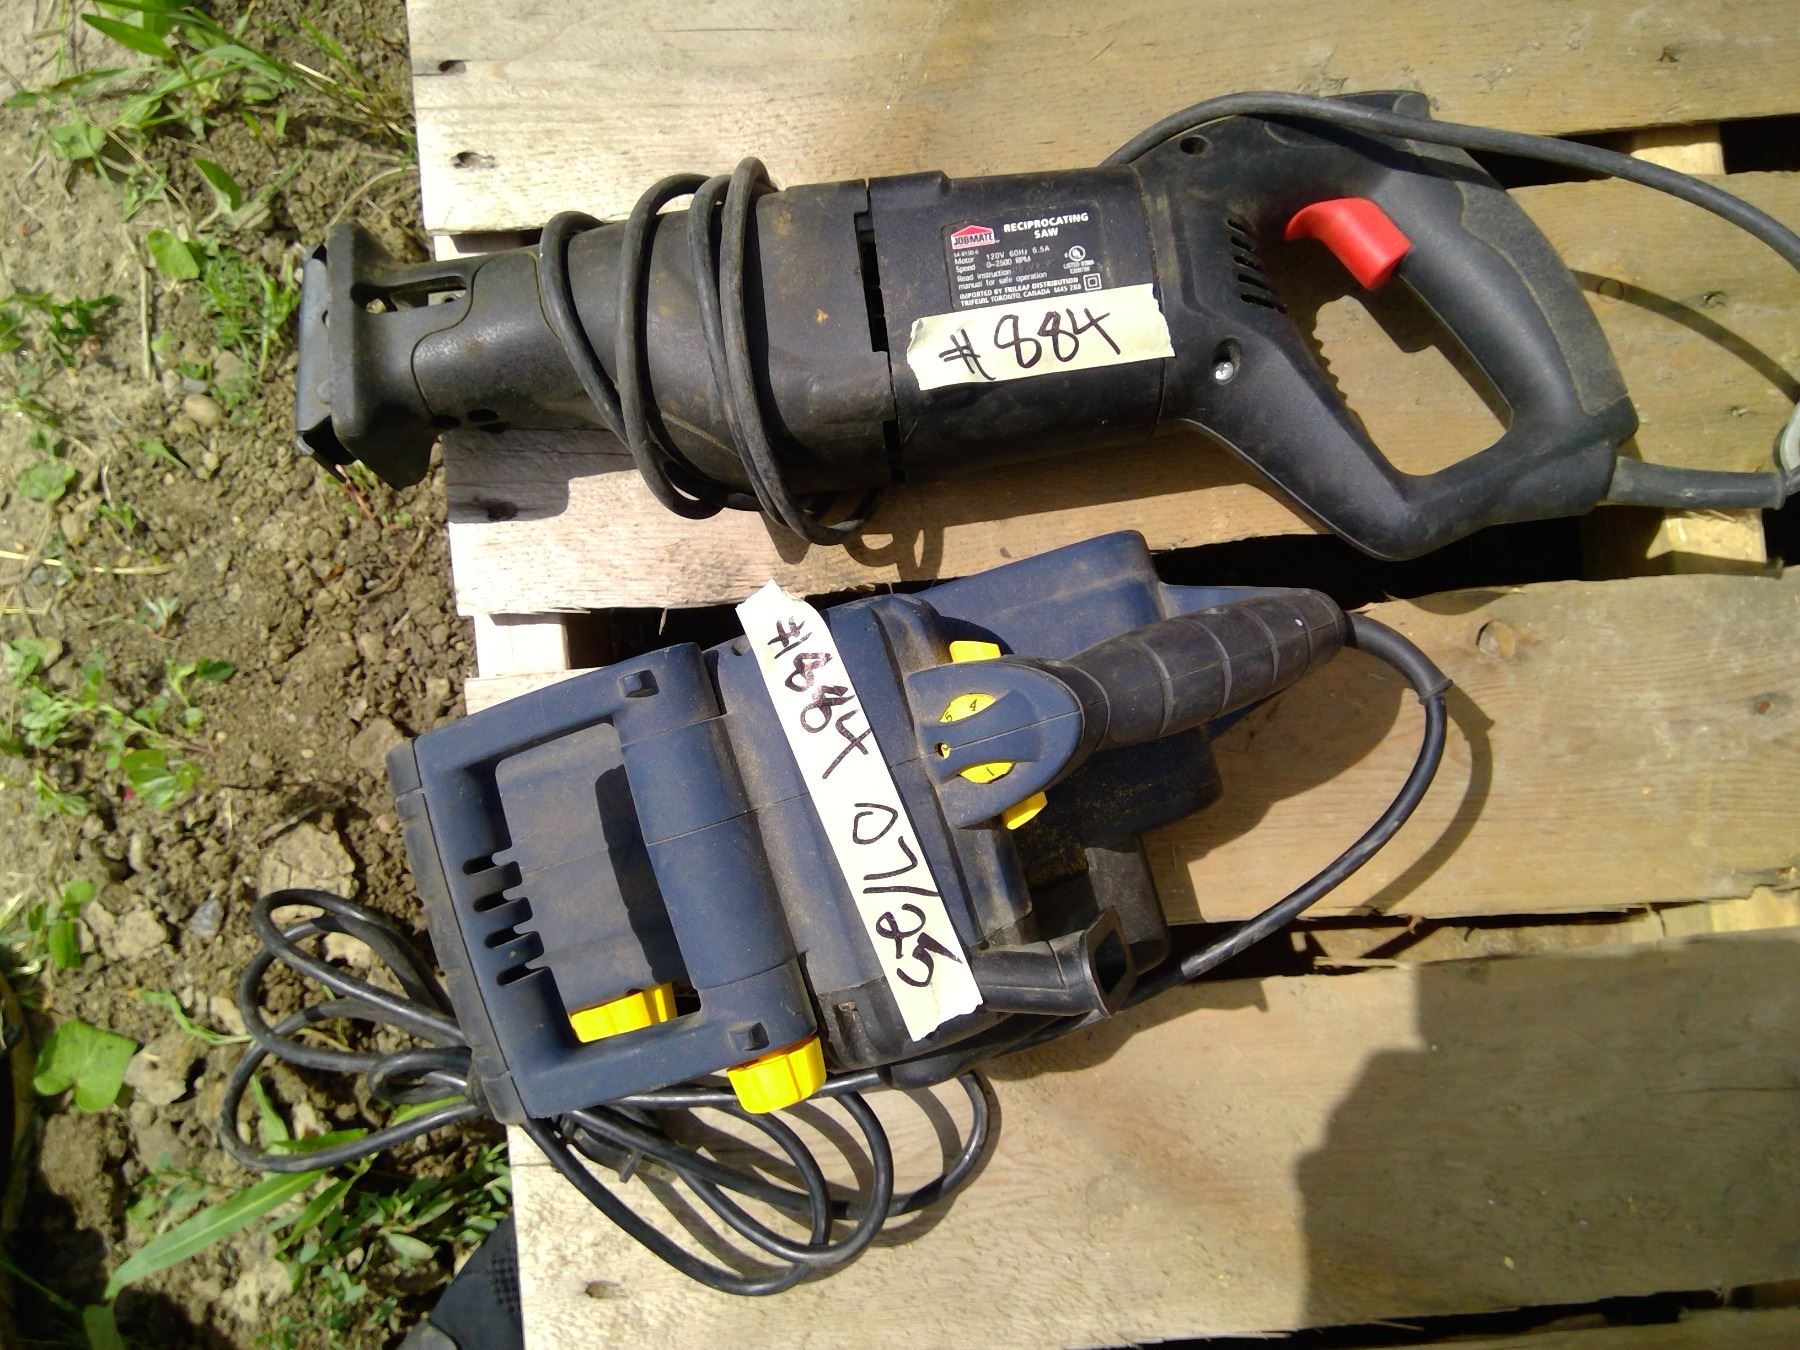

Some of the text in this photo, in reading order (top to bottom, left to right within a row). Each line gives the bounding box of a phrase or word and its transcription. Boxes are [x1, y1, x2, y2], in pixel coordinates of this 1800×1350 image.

[1003, 212, 1089, 233] RECIPROCATING
[953, 232, 993, 246] JOBMATE
[1033, 227, 1059, 239] SAW
[954, 257, 975, 265] Motor
[985, 251, 1005, 261] 120V
[1009, 248, 1028, 257] 60Hz
[955, 264, 976, 273] Speed
[1015, 256, 1031, 264] RPM
[957, 269, 1012, 282] Read instruction
[958, 271, 1048, 290] manual for safe operation
[960, 289, 993, 300] IMPORTED
[1031, 277, 1079, 289] DISTRIBUTION
[1023, 288, 1051, 298] CANADA
[969, 698, 978, 712] 4
